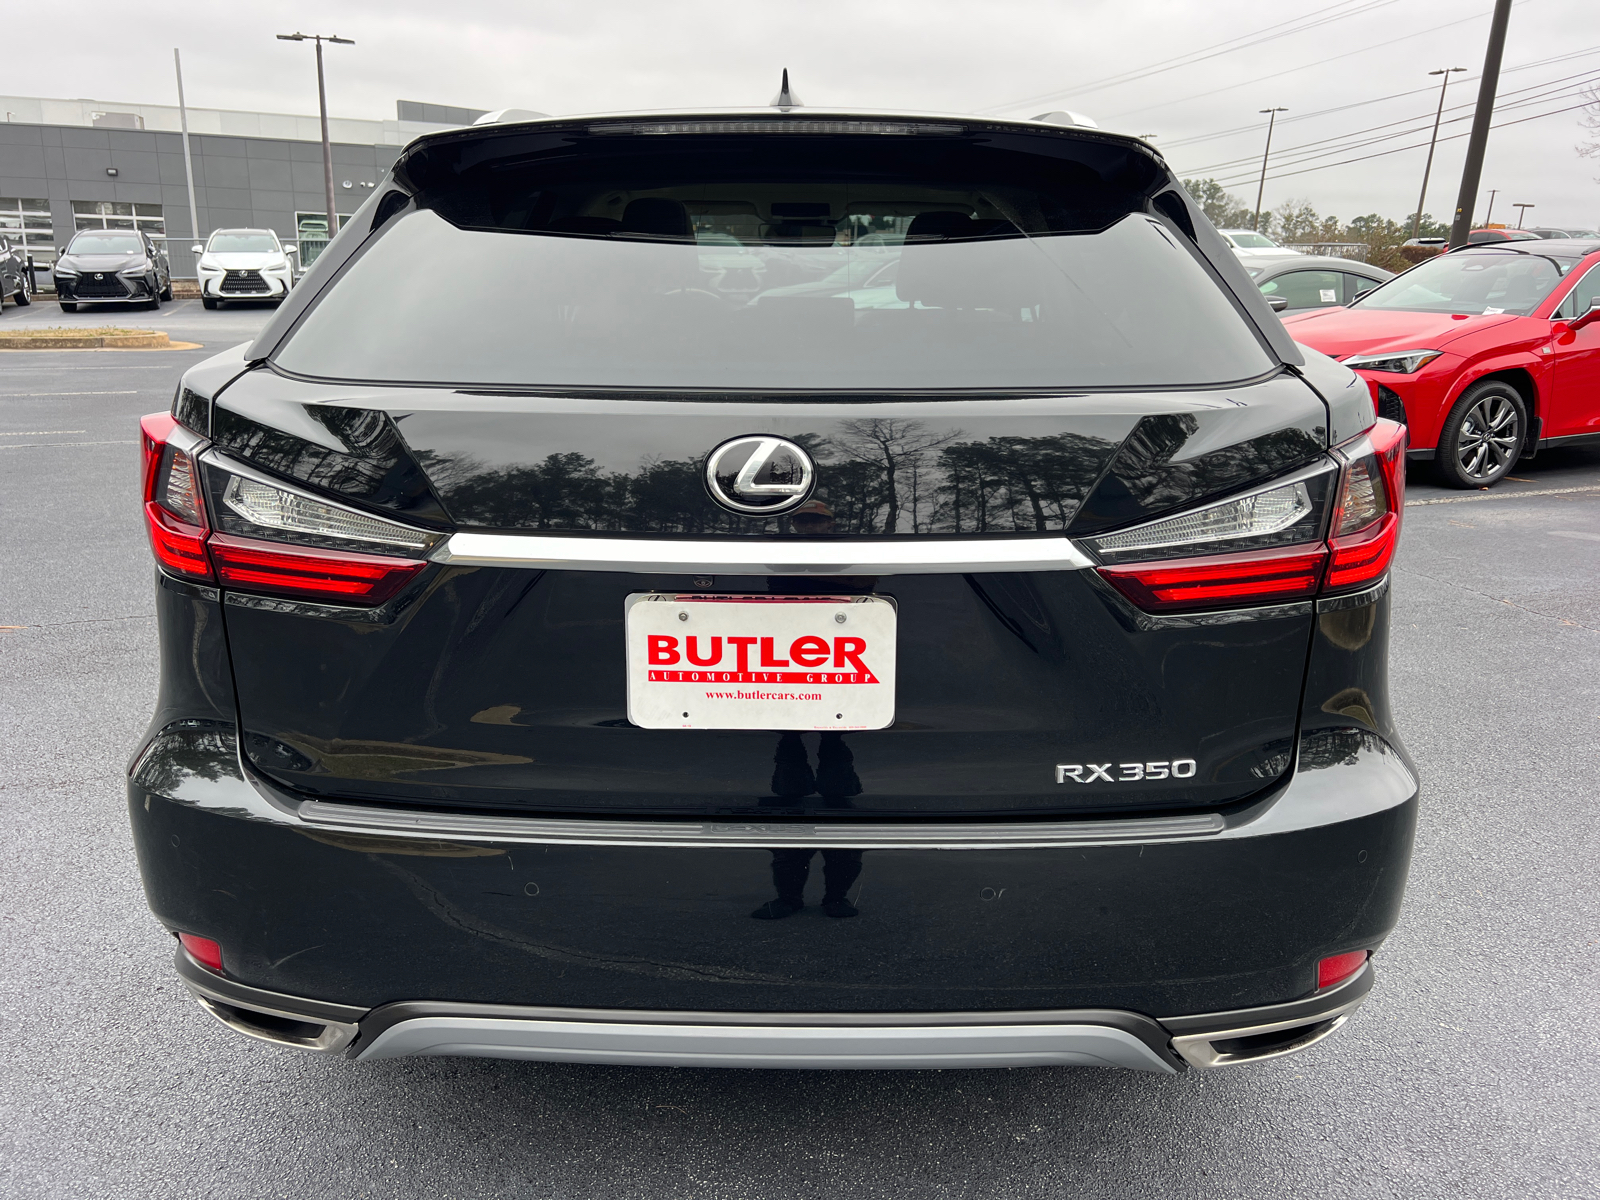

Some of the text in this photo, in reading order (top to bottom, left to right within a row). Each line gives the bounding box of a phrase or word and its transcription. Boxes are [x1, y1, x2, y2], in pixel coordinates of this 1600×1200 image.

[649, 671, 872, 683] AUTOMOTIVE GROUP
[705, 690, 822, 701] www.butlercars.com
[1055, 759, 1197, 784] RX 350
